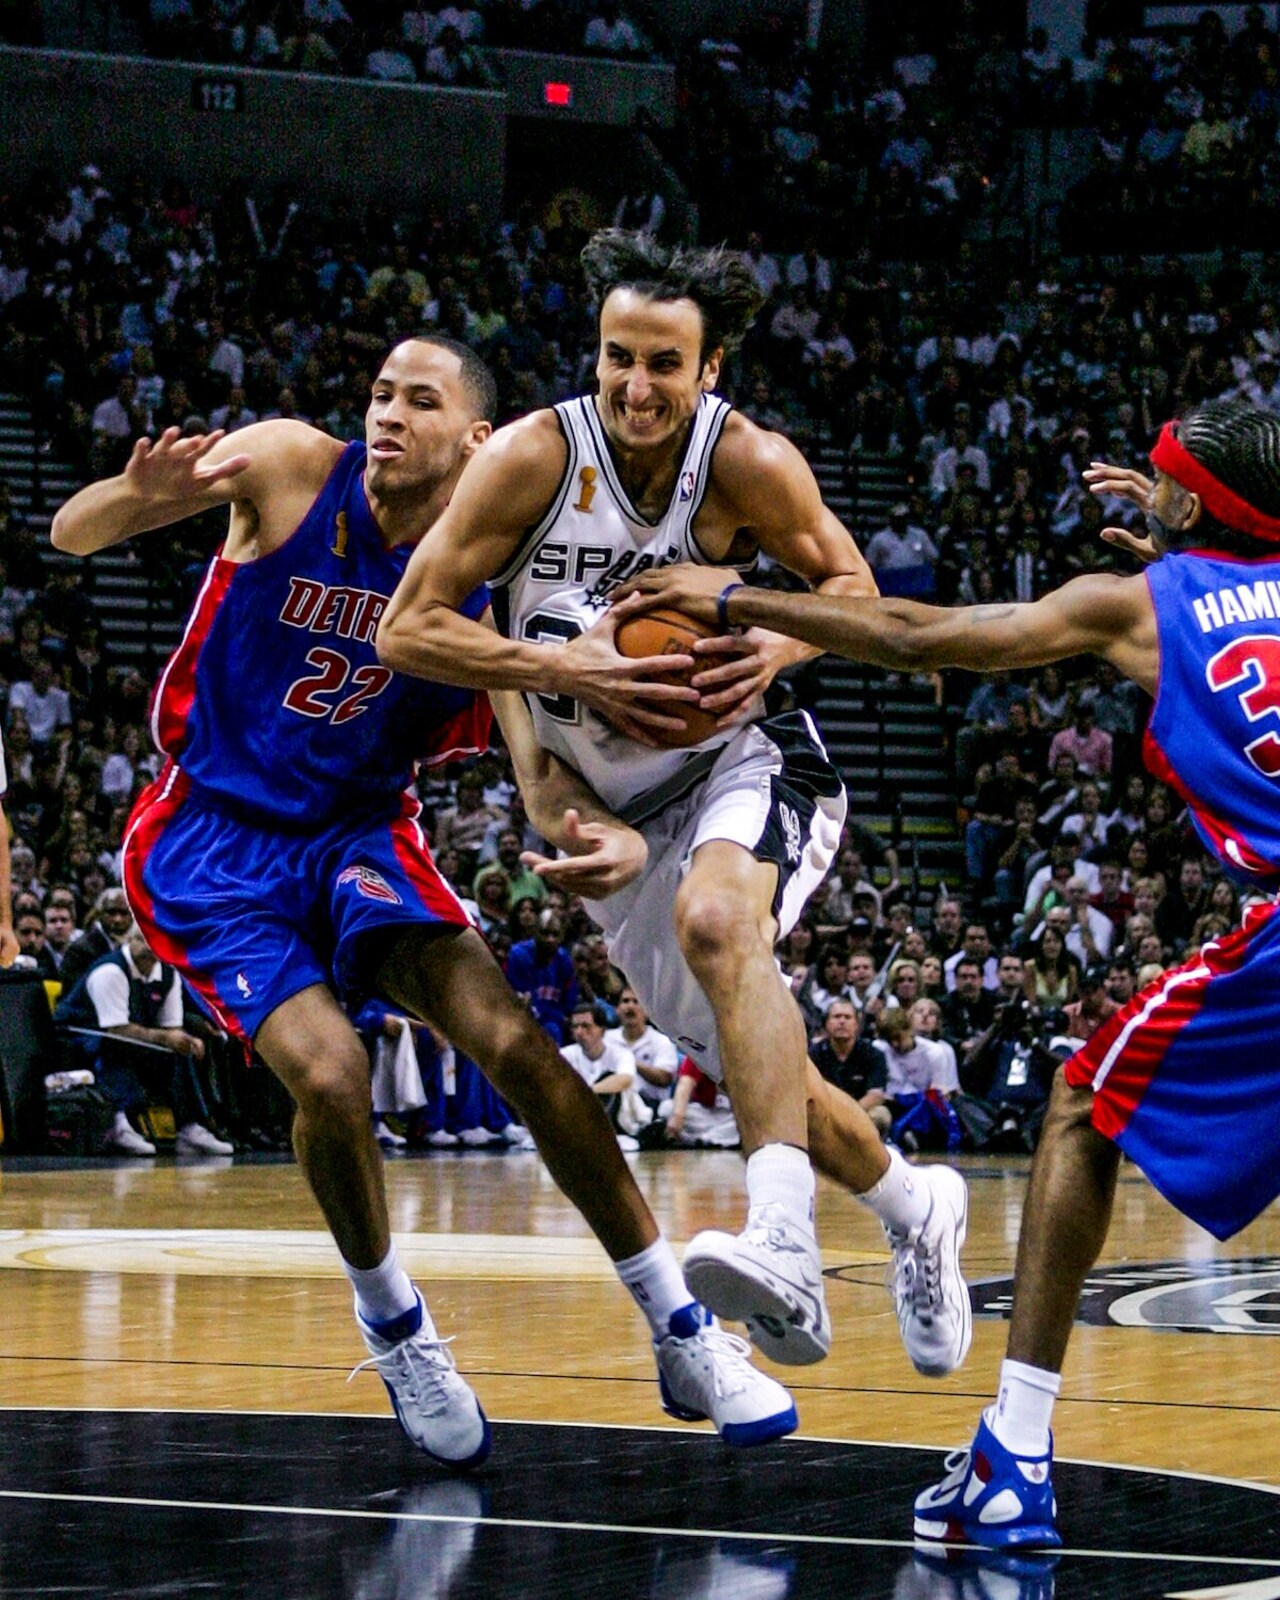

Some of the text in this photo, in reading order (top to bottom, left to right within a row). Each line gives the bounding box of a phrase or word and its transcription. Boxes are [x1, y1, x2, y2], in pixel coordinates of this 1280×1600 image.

[201, 83, 237, 109] 112
[528, 541, 682, 597] SPU
[1192, 580, 1280, 634] HAMI
[282, 646, 394, 725] 22
[1205, 634, 1280, 778] 3
